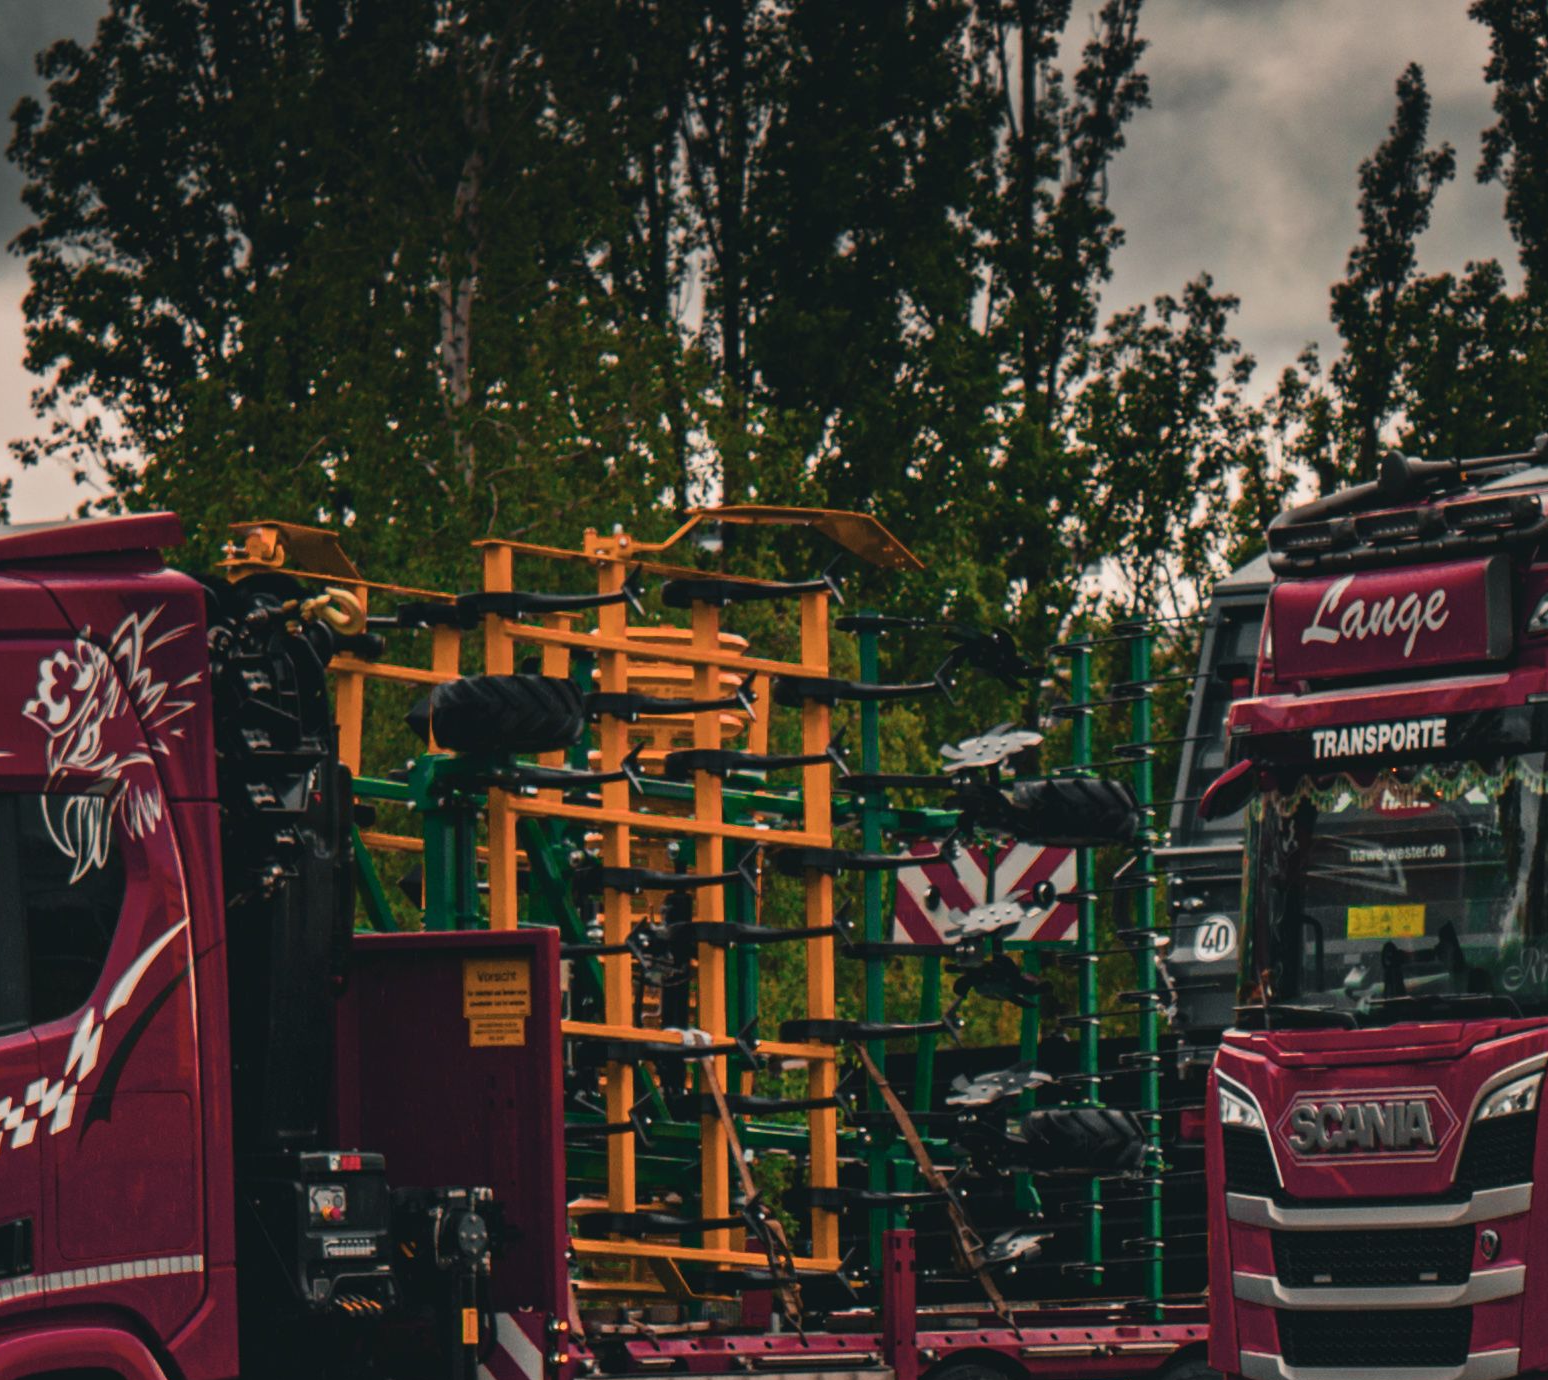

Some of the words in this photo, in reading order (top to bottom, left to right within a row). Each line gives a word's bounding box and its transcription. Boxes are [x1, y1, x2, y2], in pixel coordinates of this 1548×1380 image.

[1301, 574, 1450, 658] Lange
[1312, 717, 1448, 760] TRANSPORTE
[1202, 922, 1229, 953] 40
[1288, 1099, 1437, 1151] SCANIA
